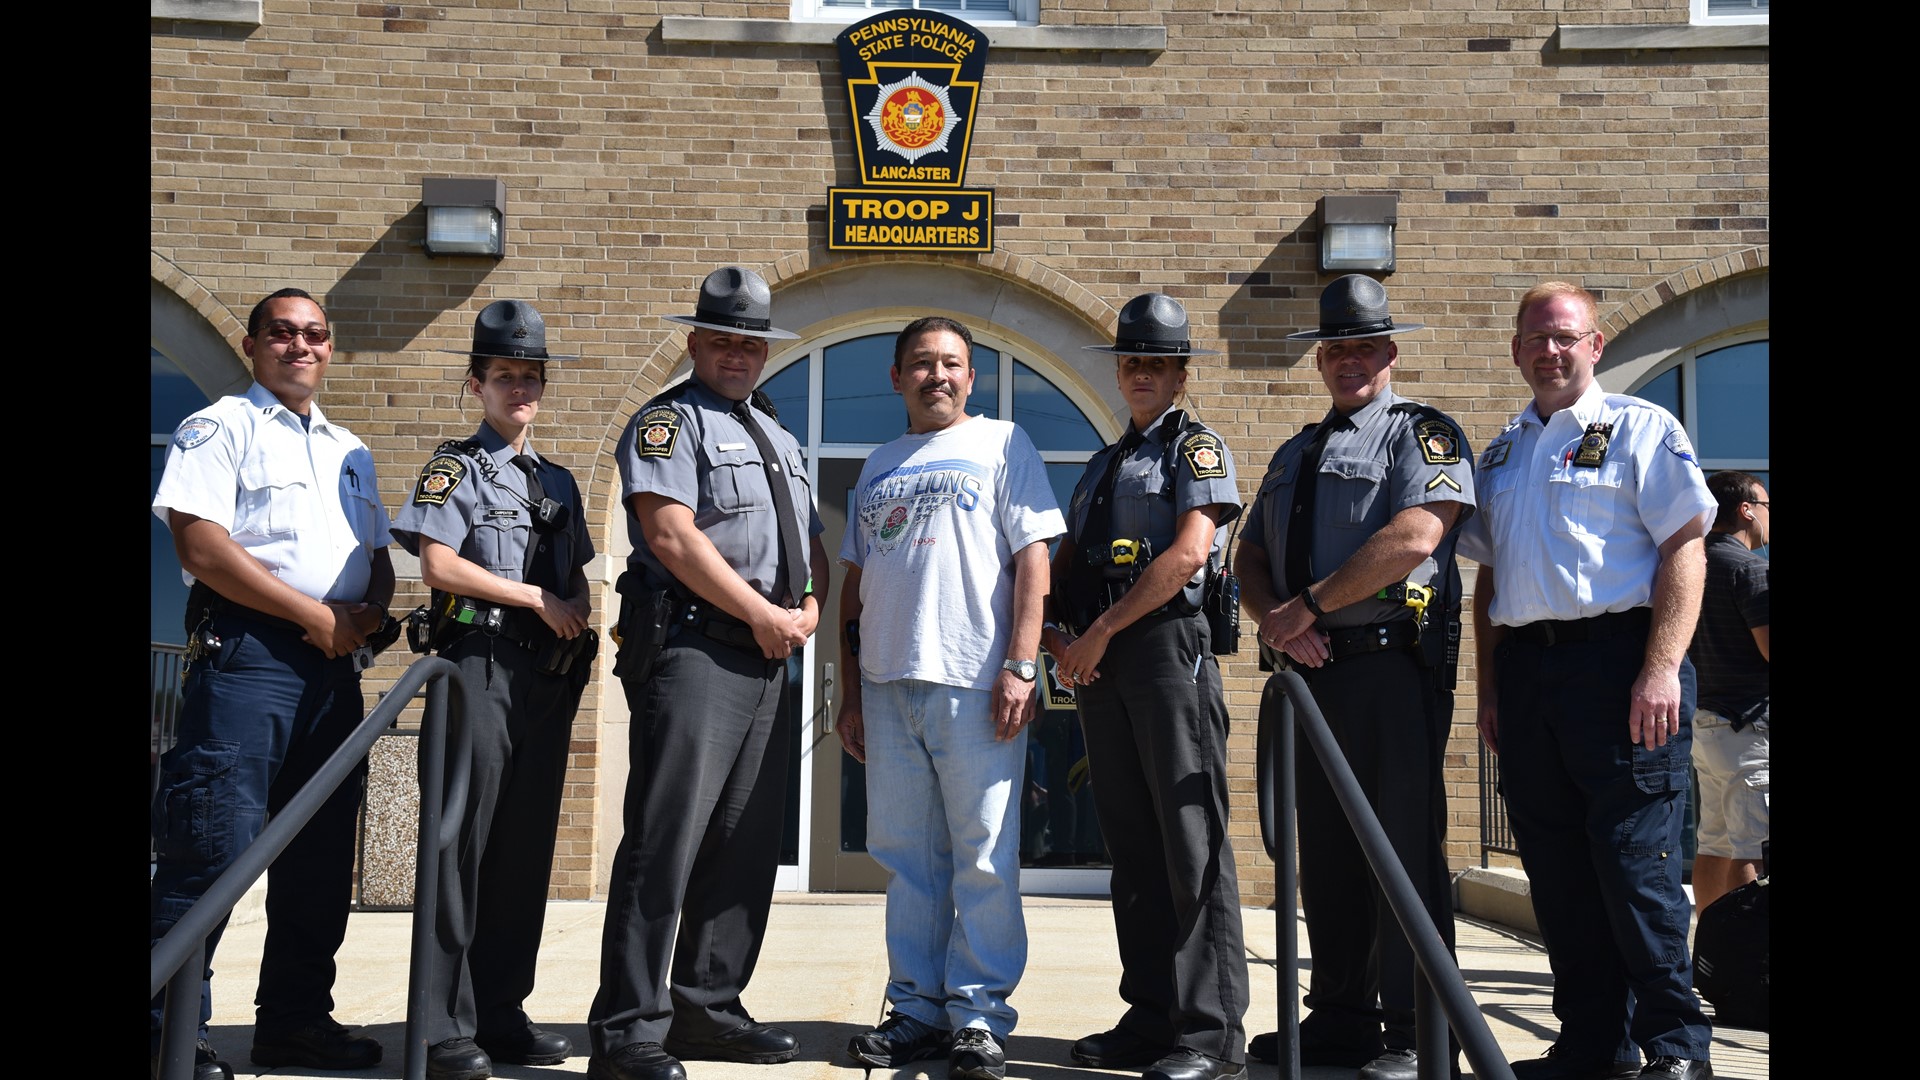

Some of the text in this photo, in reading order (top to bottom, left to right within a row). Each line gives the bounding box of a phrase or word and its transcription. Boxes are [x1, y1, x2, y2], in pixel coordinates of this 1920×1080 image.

[849, 17, 976, 53] PENNSYLVANIA
[858, 33, 967, 63] STATE POLICE
[872, 166, 950, 181] LANCASTER
[842, 199, 979, 221] TROOP J
[845, 225, 979, 245] HEADQUARTERS
[914, 471, 983, 511] LIONS
[912, 537, 937, 547] 1995
[1052, 696, 1077, 704] TROO
